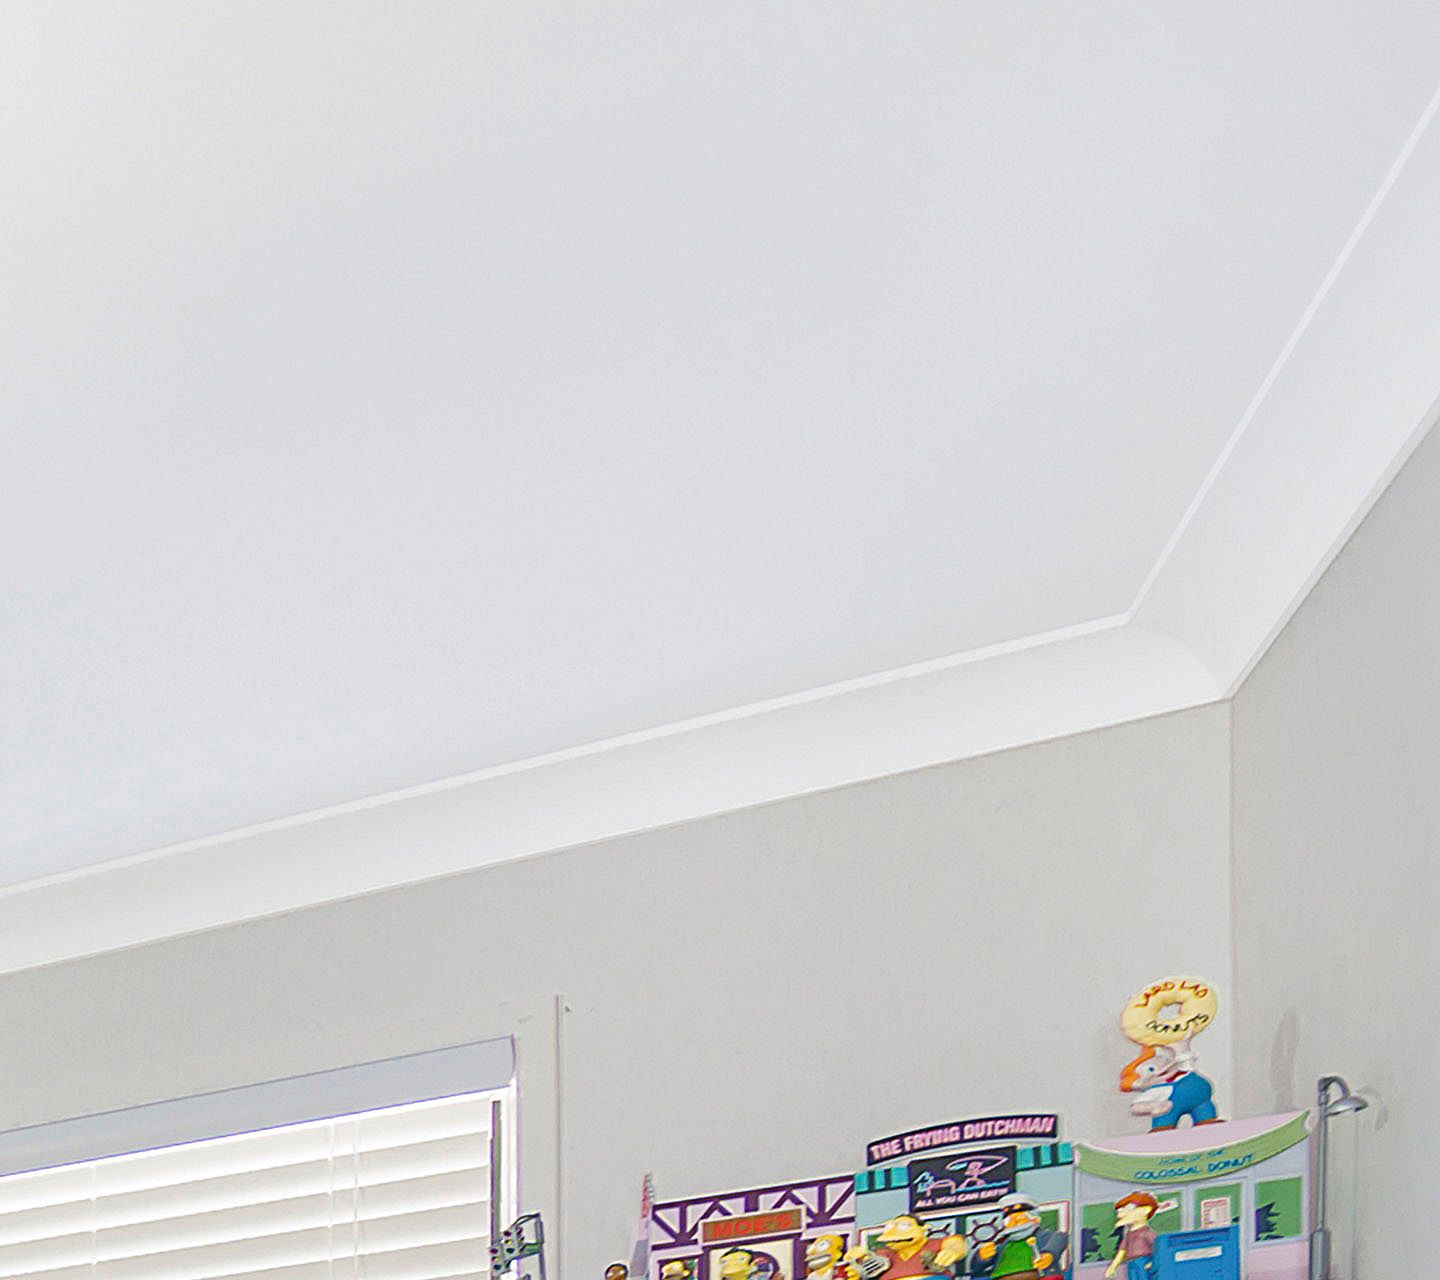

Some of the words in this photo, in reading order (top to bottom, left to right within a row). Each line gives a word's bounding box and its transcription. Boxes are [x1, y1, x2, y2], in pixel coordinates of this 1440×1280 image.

[870, 1138, 902, 1160] THE
[904, 1124, 961, 1151] FRYING
[963, 1115, 1056, 1140] DUTCHMAN
[711, 1211, 795, 1237] MOE'S
